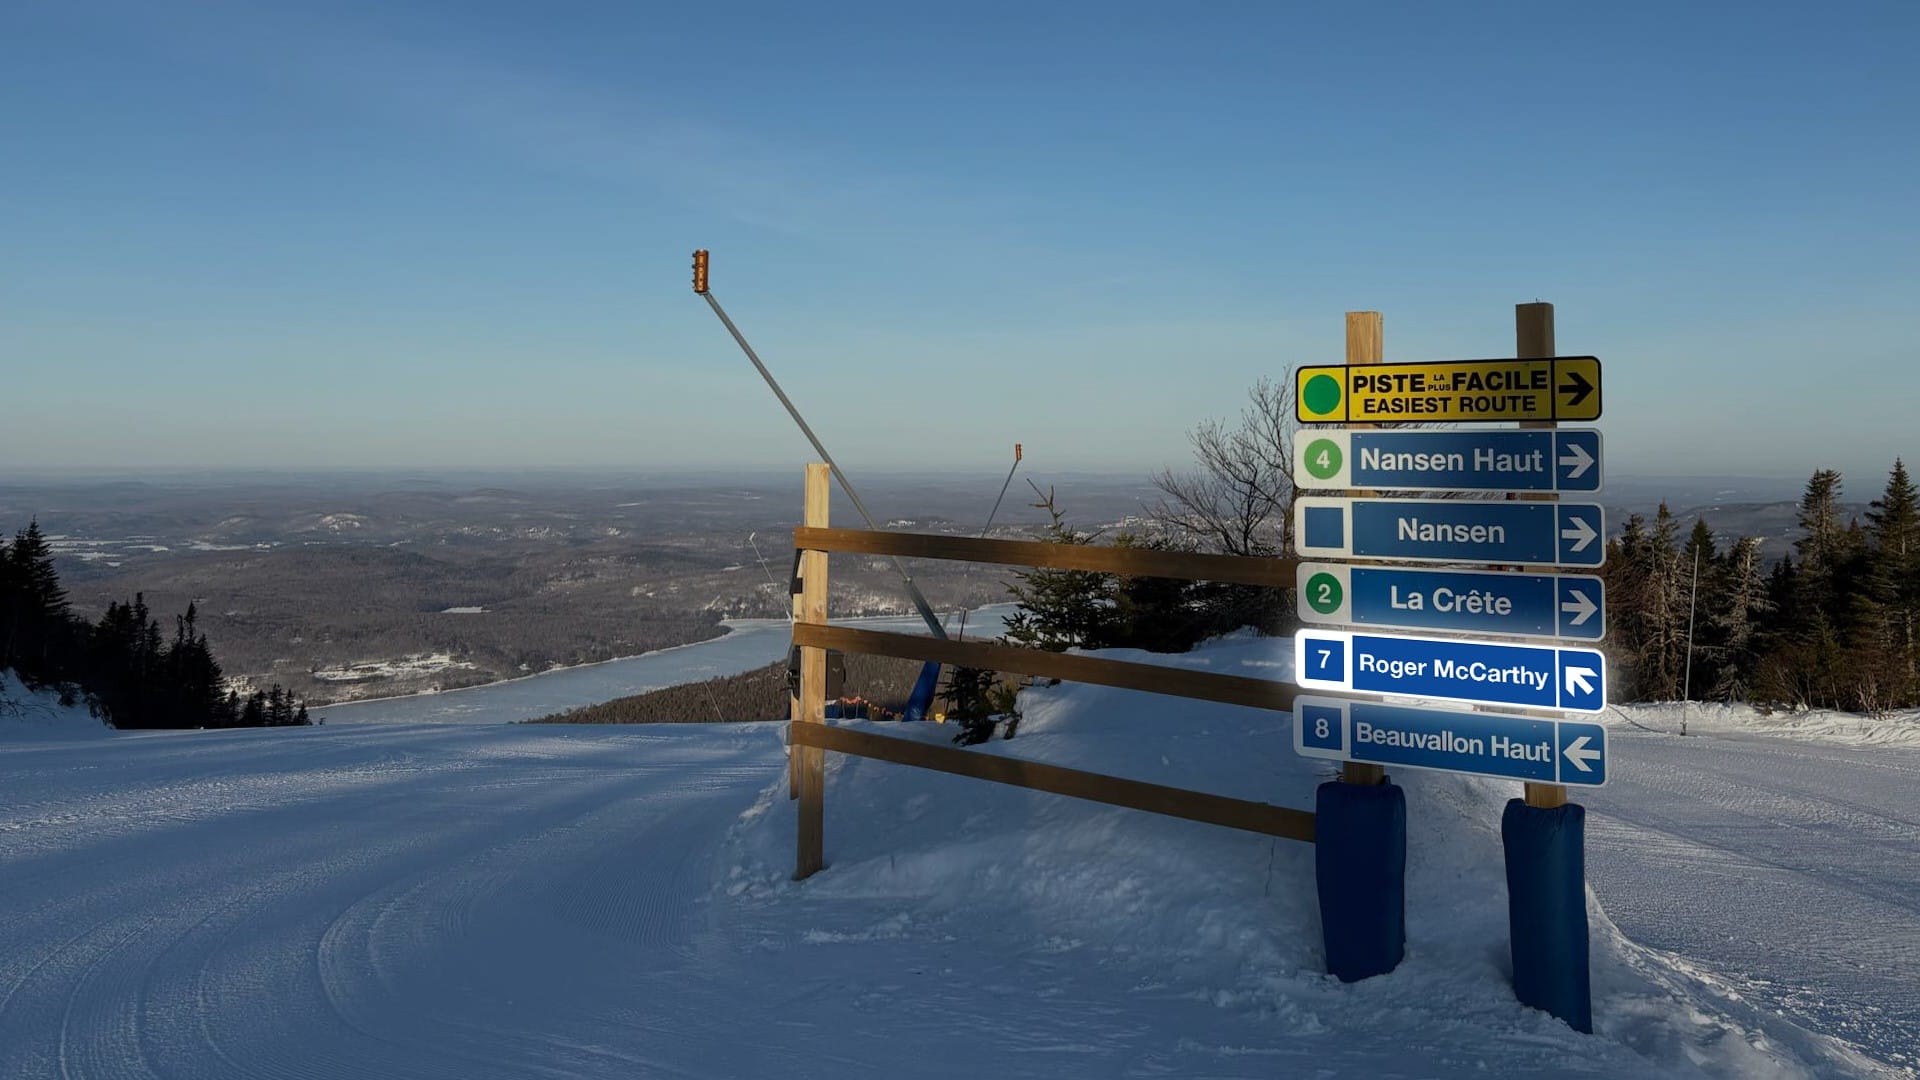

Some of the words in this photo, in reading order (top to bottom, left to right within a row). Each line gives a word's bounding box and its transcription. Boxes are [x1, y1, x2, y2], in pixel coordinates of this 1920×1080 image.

[1353, 373, 1426, 394] PISTE
[1452, 370, 1547, 391] FACILE
[1428, 384, 1451, 392] PLUS
[1433, 374, 1445, 382] LA
[1364, 396, 1452, 414] EASIEST
[1459, 395, 1536, 413] ROUTE
[1316, 450, 1330, 469] 4
[1360, 447, 1464, 471] Nansen
[1474, 448, 1543, 473] Haut
[1398, 518, 1505, 544] Nansen
[1318, 584, 1331, 603] 2
[1390, 585, 1424, 611] La
[1432, 587, 1512, 616] Crête
[1318, 650, 1331, 669] 7
[1359, 653, 1427, 679] Roger
[1434, 659, 1549, 690] McCarthy
[1315, 718, 1329, 739] 8
[1356, 722, 1485, 756] Beauvallon
[1491, 735, 1551, 763] Haut
